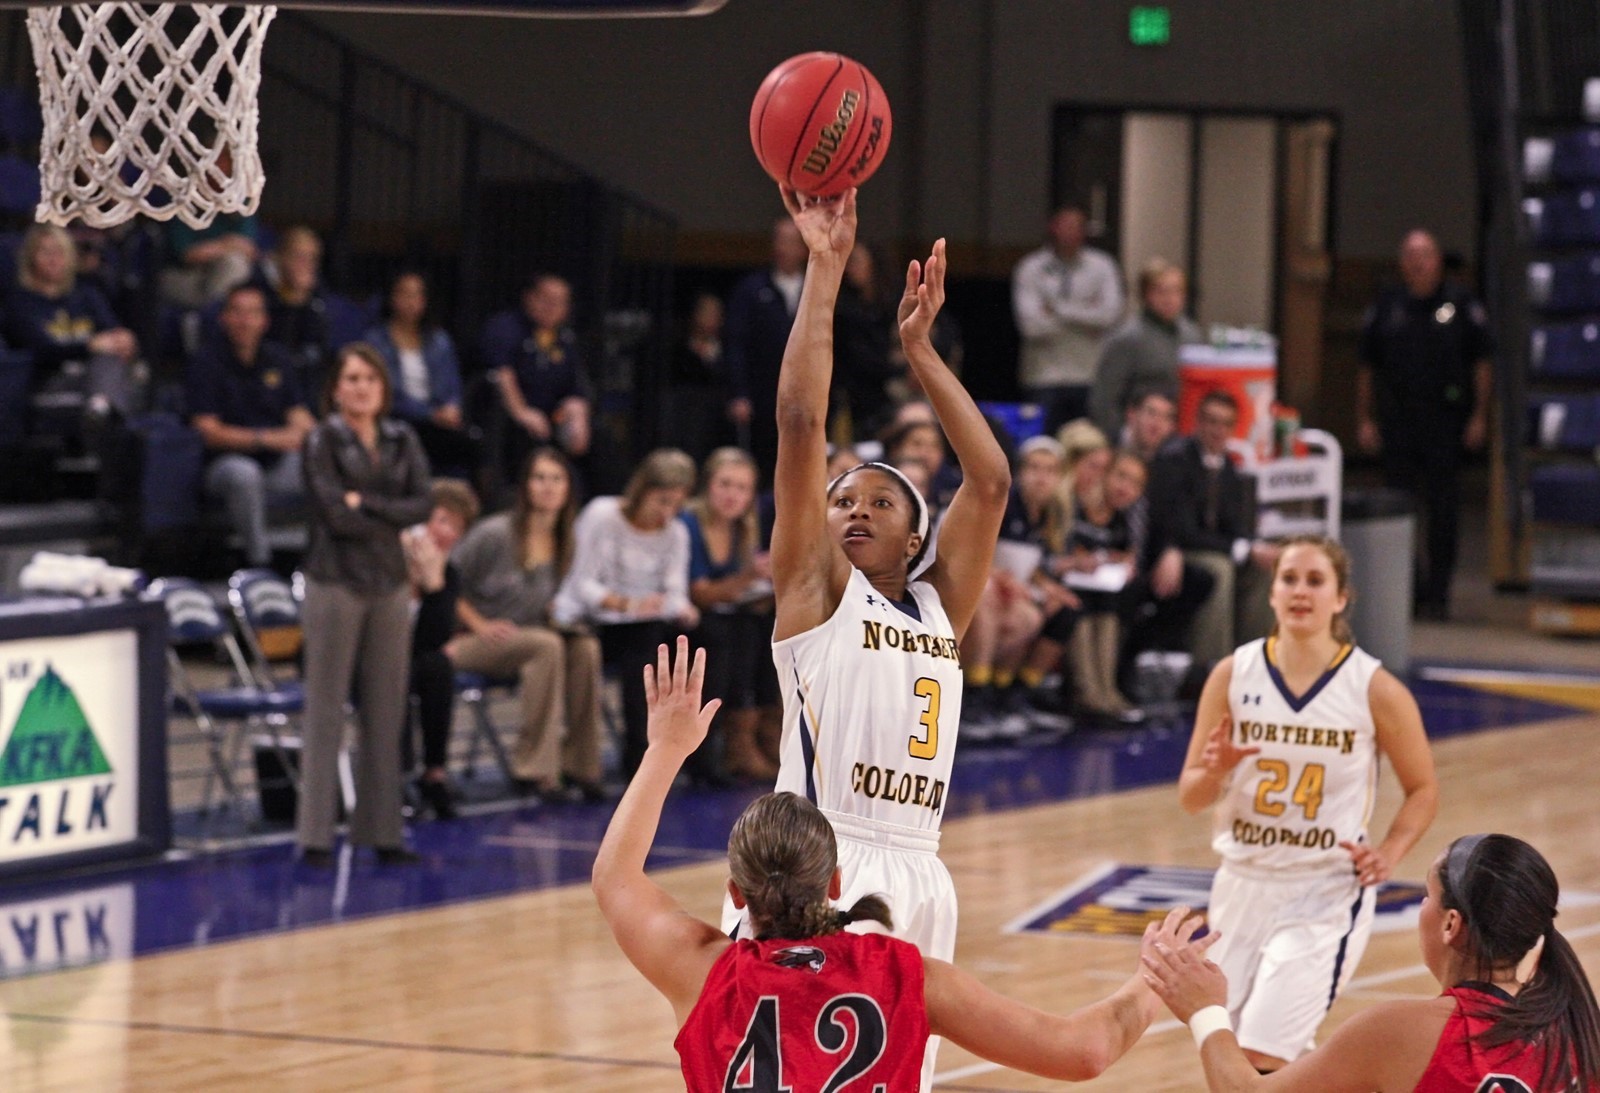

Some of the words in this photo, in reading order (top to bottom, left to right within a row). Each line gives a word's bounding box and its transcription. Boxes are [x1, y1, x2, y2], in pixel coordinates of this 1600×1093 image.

[803, 89, 860, 175] Wilson
[908, 676, 941, 761] 3
[1240, 721, 1356, 753] NORTHERN
[1254, 759, 1325, 820] 24
[724, 993, 887, 1093] 42
